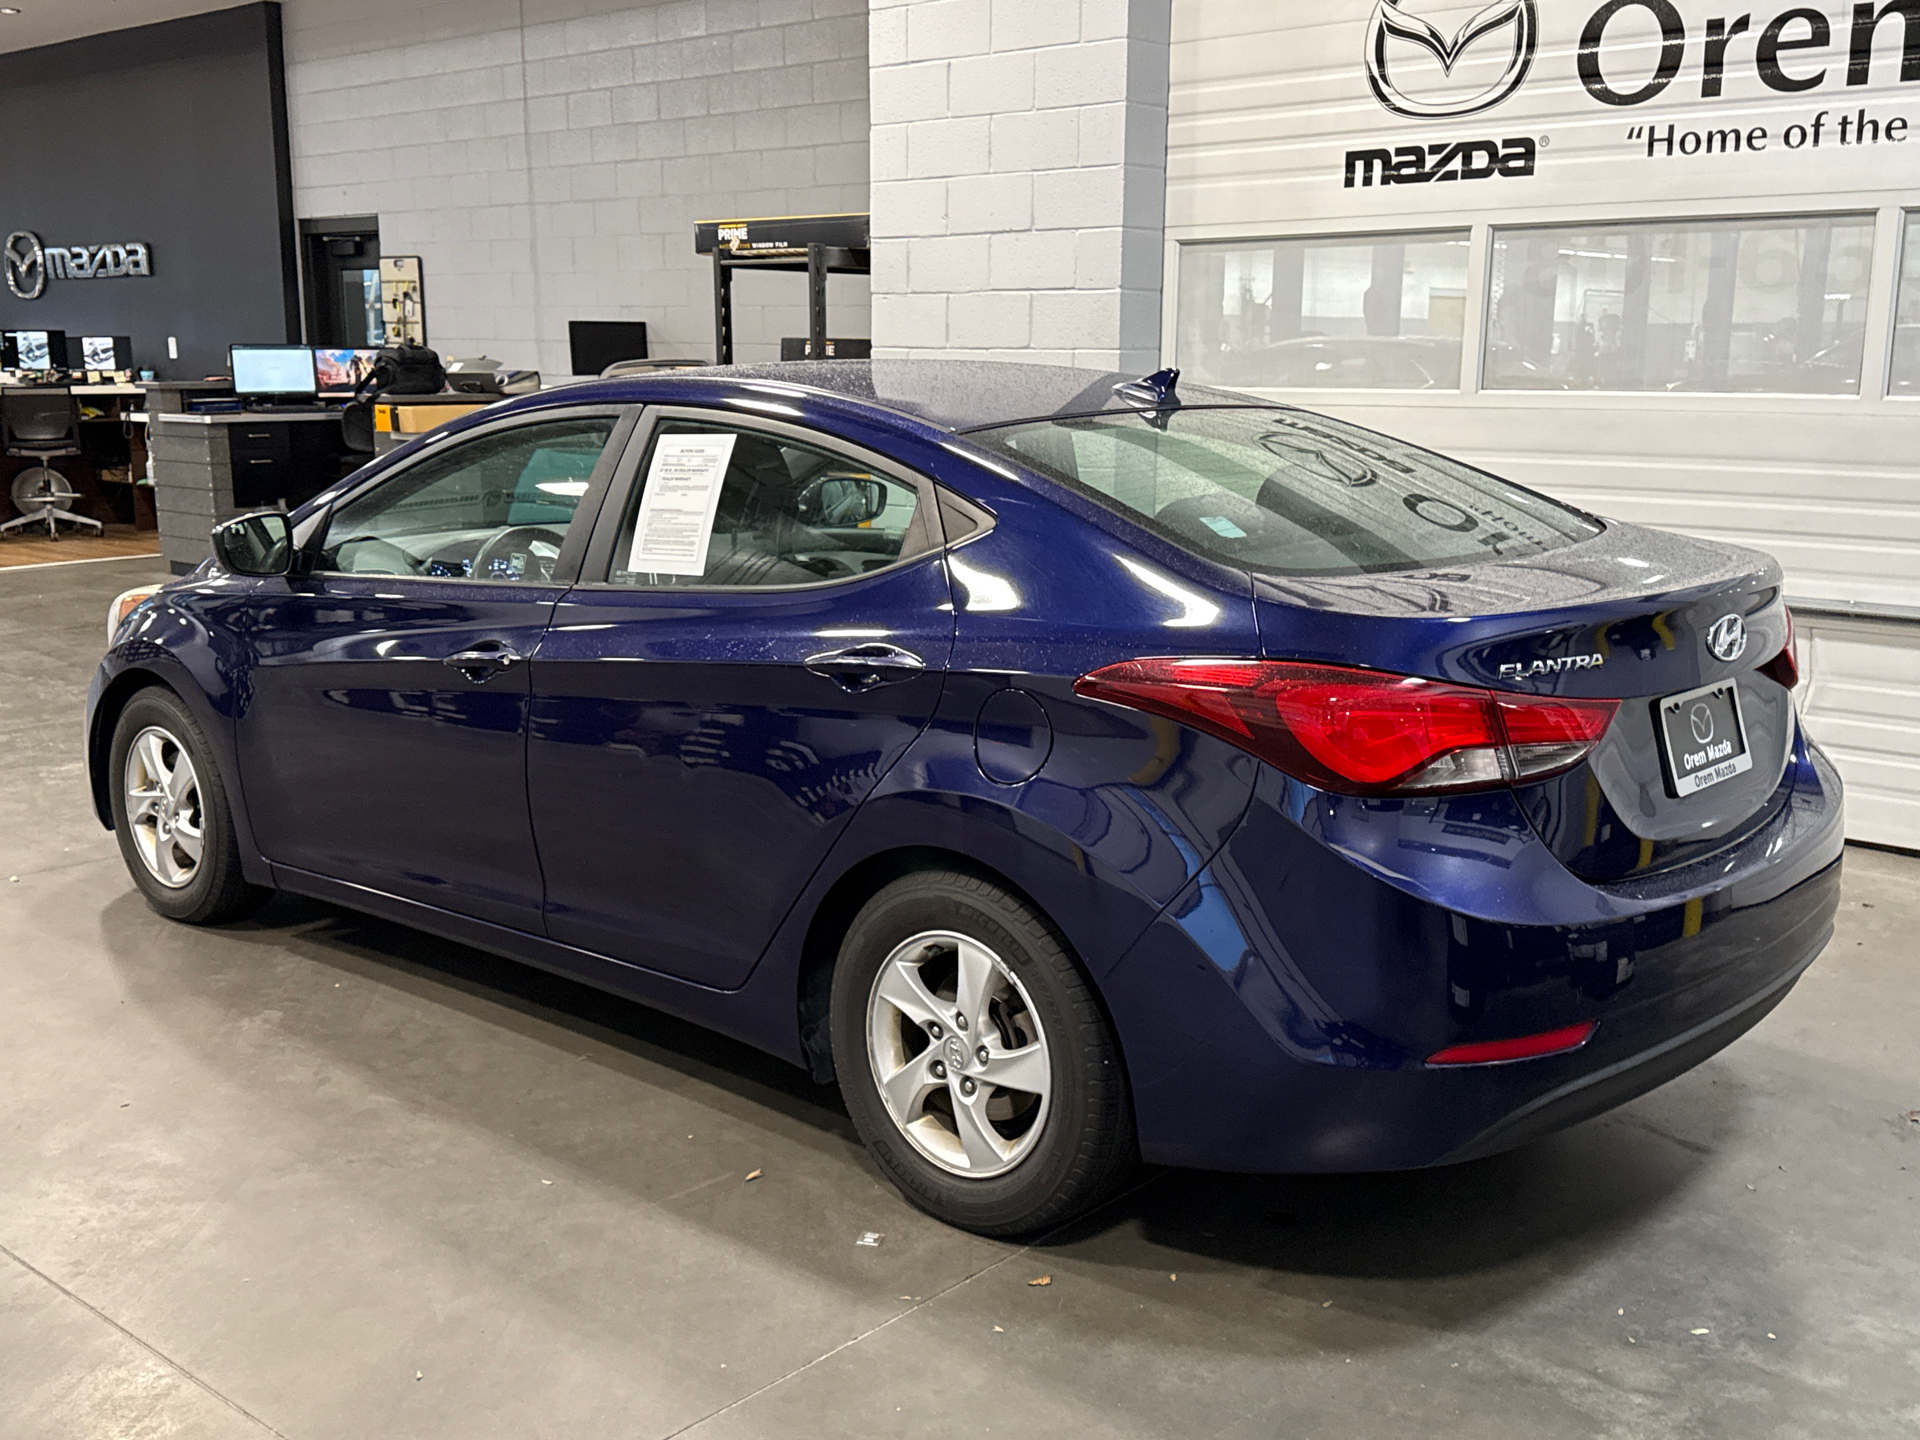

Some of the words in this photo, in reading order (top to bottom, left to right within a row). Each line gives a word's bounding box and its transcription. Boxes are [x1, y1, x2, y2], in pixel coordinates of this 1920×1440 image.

[1782, 110, 1829, 149] of
[1838, 109, 1908, 145] the
[717, 227, 748, 241] PRIME
[1498, 653, 1604, 681] ELANTRA
[1683, 749, 1708, 770] Orem
[1706, 738, 1733, 761] Mazda
[1694, 770, 1715, 788] Orem
[1714, 761, 1738, 779] Mazda
